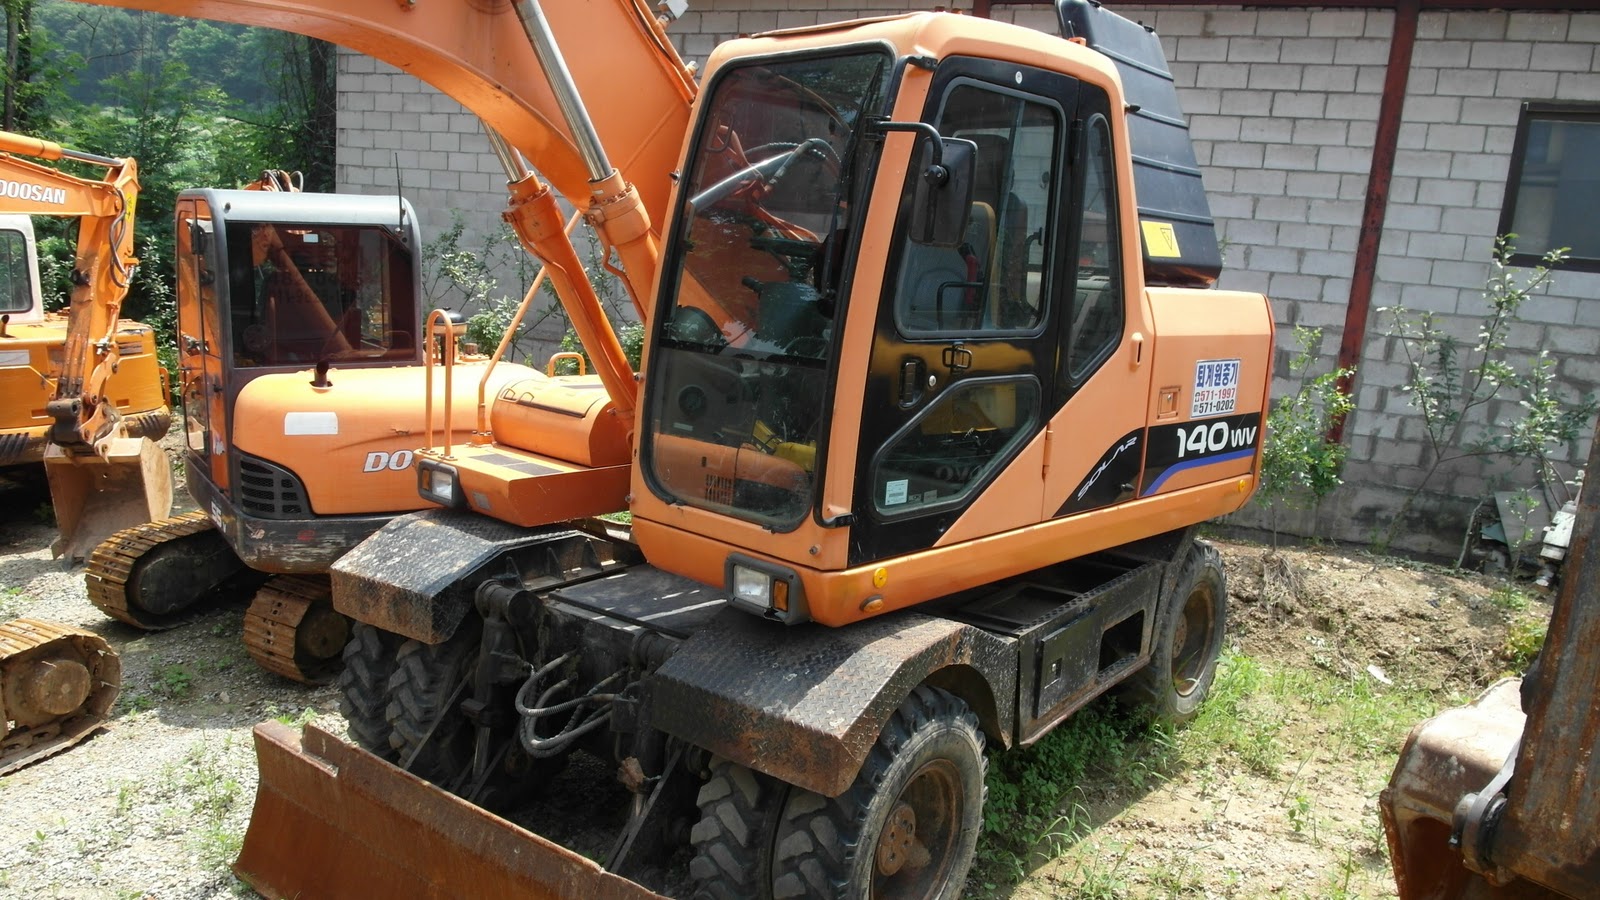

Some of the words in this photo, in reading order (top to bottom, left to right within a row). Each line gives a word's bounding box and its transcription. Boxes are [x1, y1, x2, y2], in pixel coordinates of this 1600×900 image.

[1196, 363, 1239, 387] 퇴계원중기
[1200, 388, 1236, 402] 571-1997
[1198, 399, 1235, 414] 571-0202
[363, 449, 414, 473] DO
